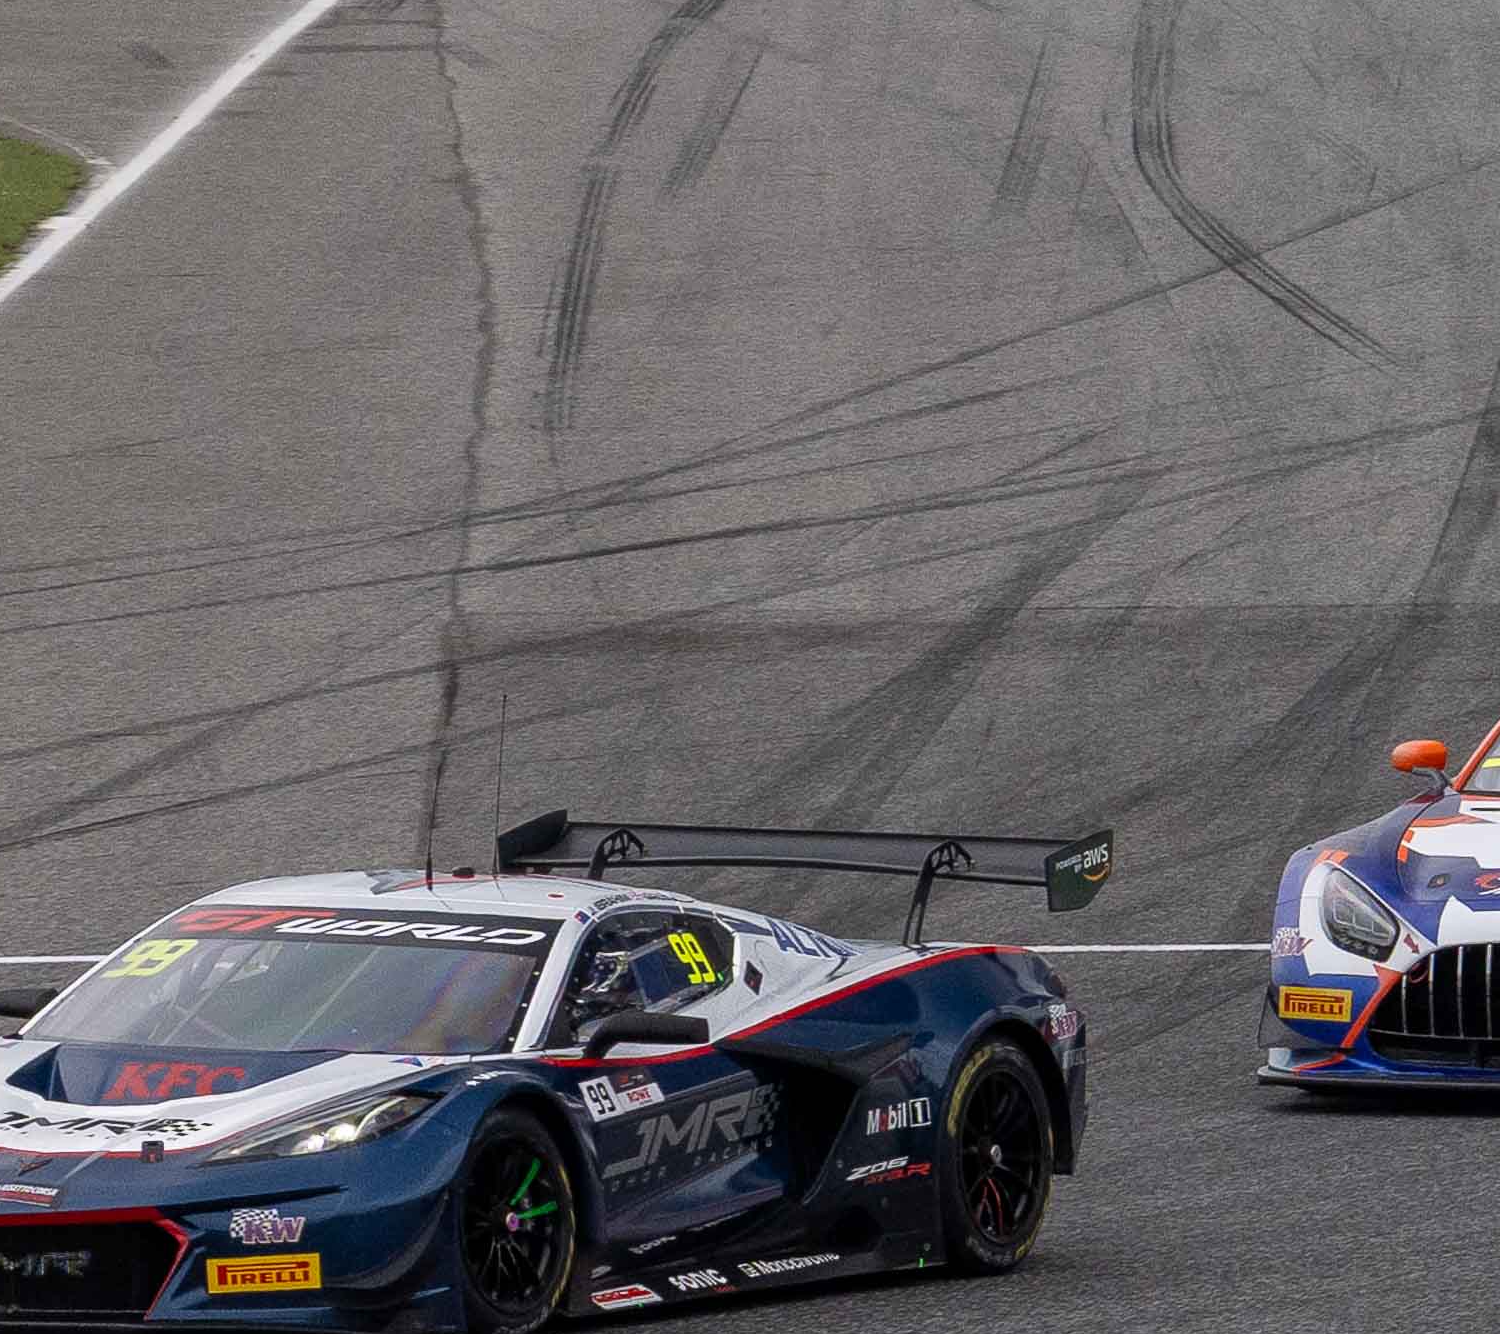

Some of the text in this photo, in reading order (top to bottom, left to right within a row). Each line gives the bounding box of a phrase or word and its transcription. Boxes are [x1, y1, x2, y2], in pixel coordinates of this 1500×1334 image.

[1082, 843, 1110, 868] aws
[274, 916, 548, 946] WORLD
[101, 937, 200, 978] 99
[667, 931, 716, 985] 99
[1283, 991, 1345, 1019] PIRELLI
[102, 1061, 246, 1101] KFC
[586, 1081, 618, 1114] 99
[865, 1106, 908, 1136] Mobil
[215, 1258, 312, 1291] PIRELLI
